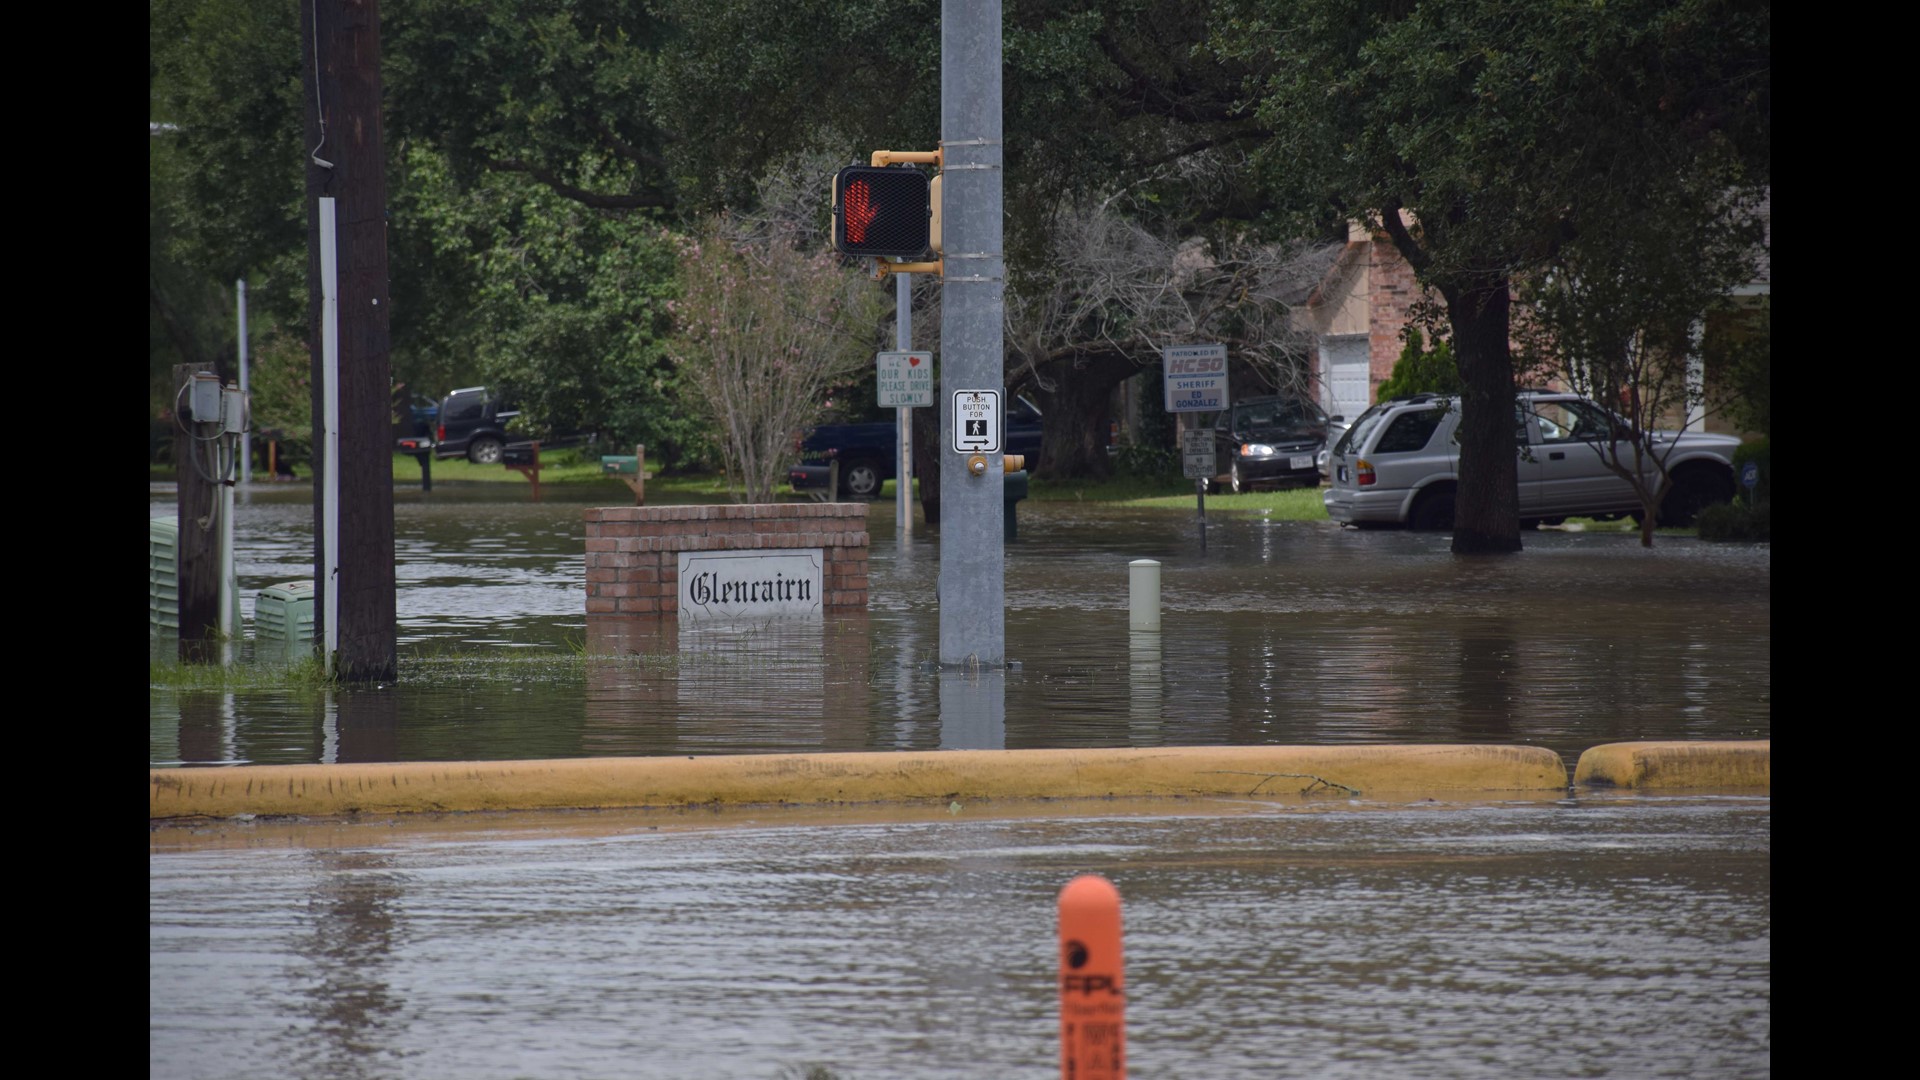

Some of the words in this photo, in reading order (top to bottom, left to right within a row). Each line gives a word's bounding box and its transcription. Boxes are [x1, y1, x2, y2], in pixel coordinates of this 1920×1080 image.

[1169, 358, 1224, 373] HCSO
[881, 369, 899, 379] OUR
[907, 369, 929, 379] KIDS
[880, 381, 906, 391] PLEASE
[910, 381, 930, 391] DRIVE
[1177, 380, 1216, 389] SHERIFF
[889, 393, 923, 404] SLOWLY
[1176, 399, 1219, 408] GONZALEZ
[689, 571, 811, 606] Glencairn
